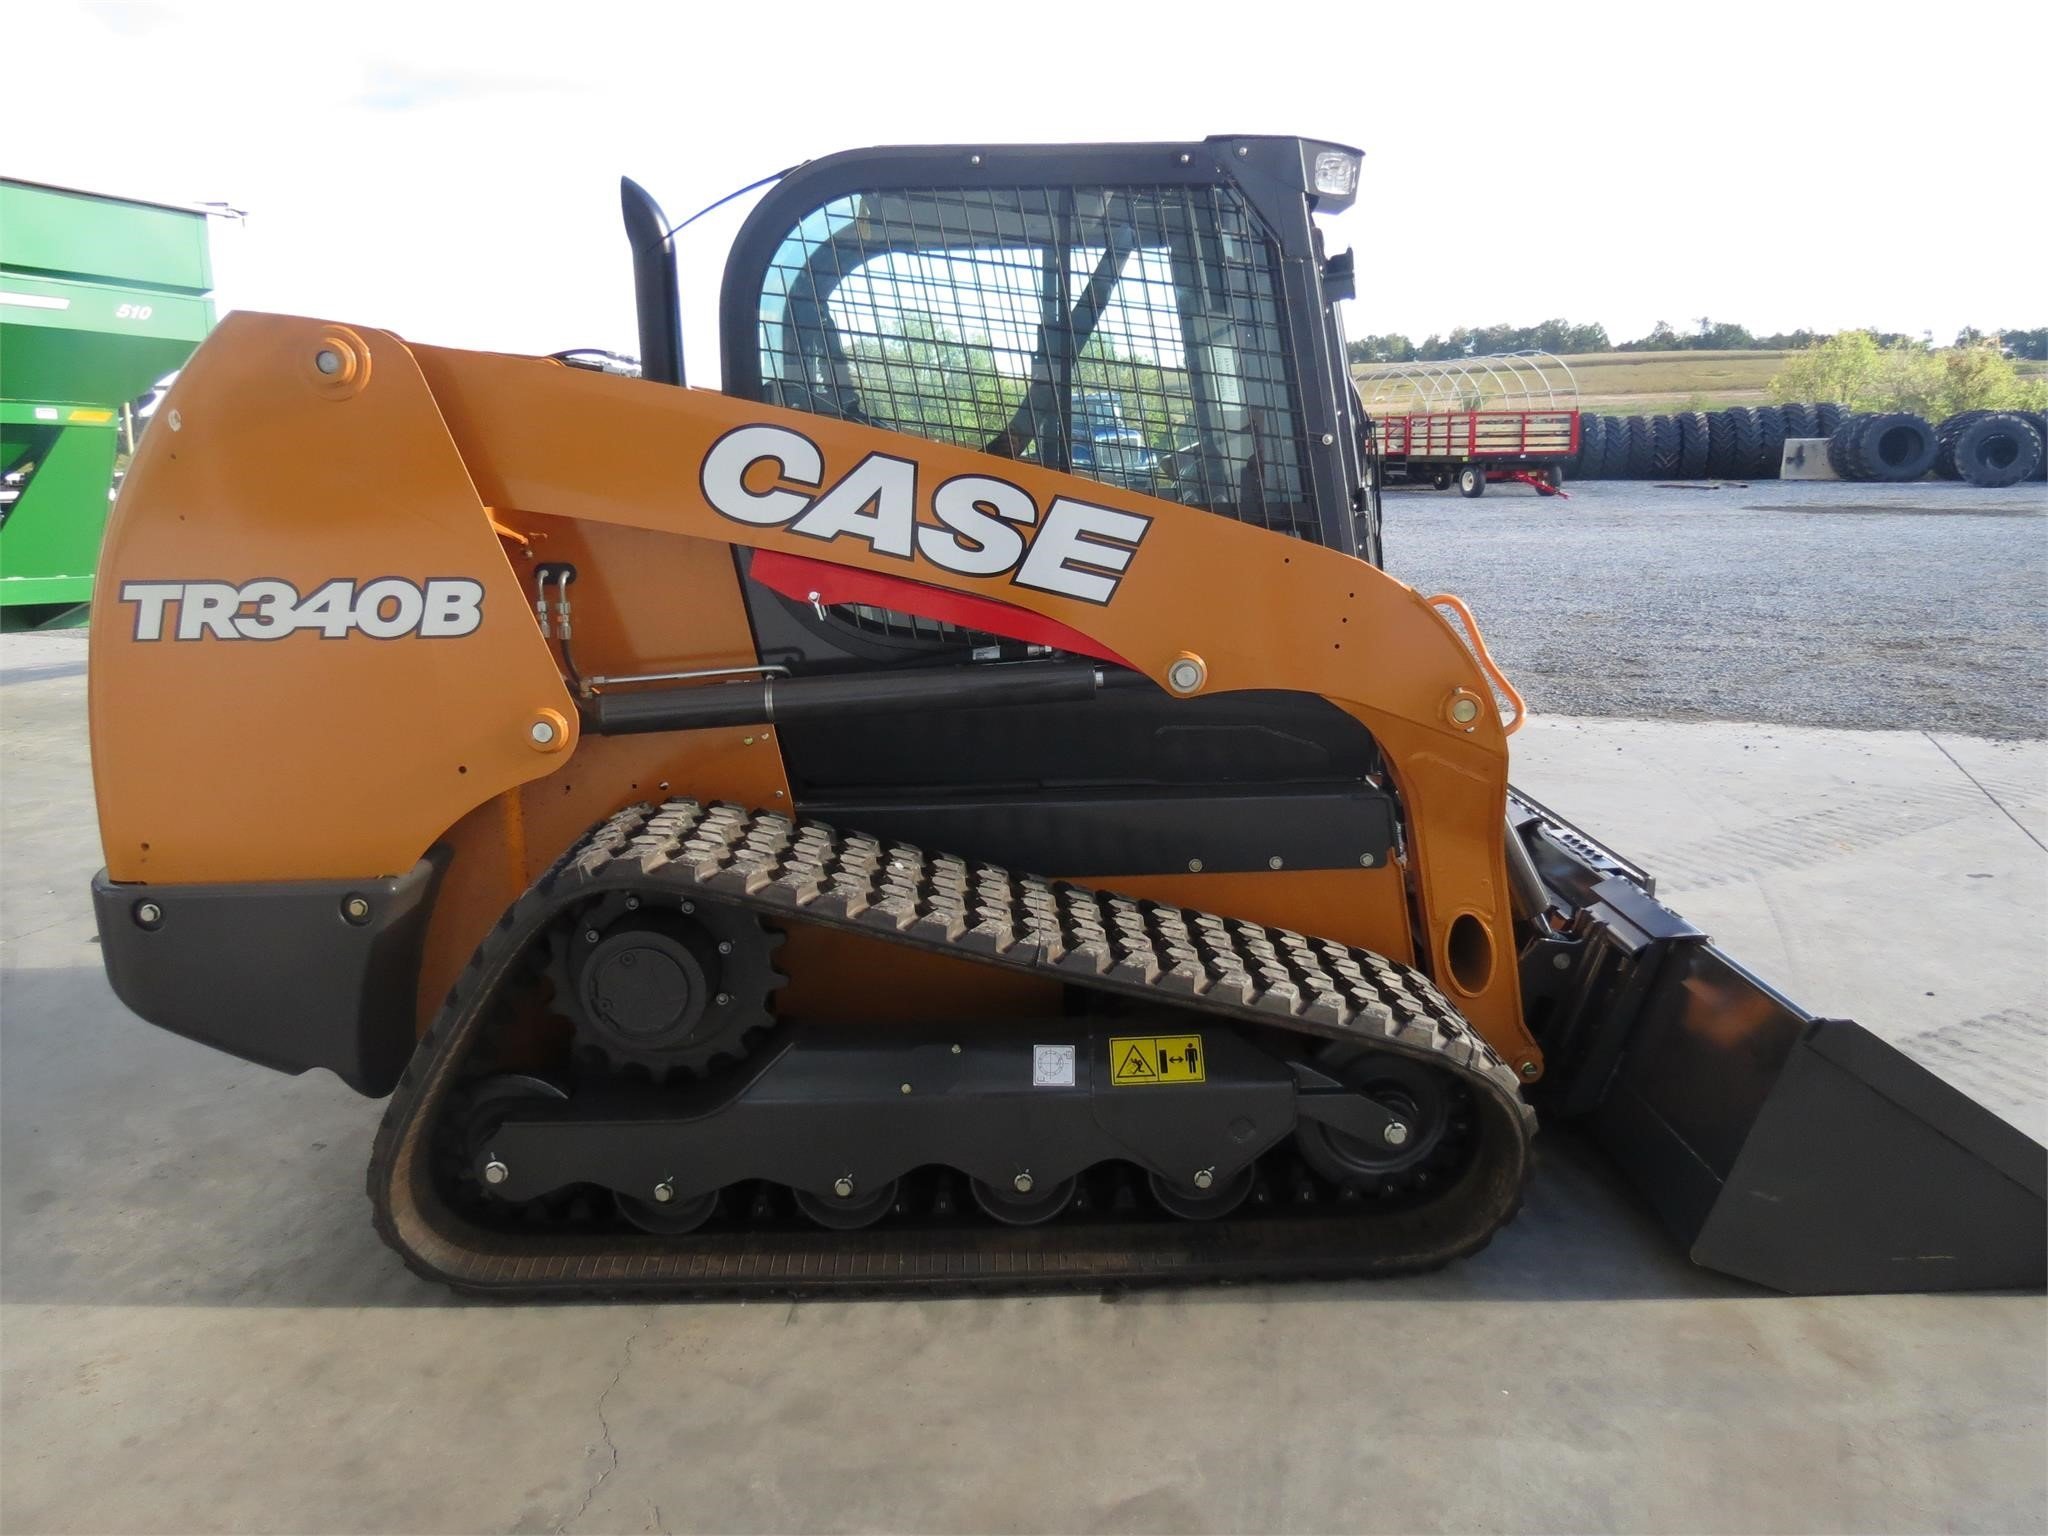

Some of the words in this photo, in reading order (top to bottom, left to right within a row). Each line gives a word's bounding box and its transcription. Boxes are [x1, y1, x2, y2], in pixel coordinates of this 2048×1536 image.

[115, 303, 153, 320] 510
[700, 423, 1154, 606] CASE
[120, 576, 484, 641] TR340B
